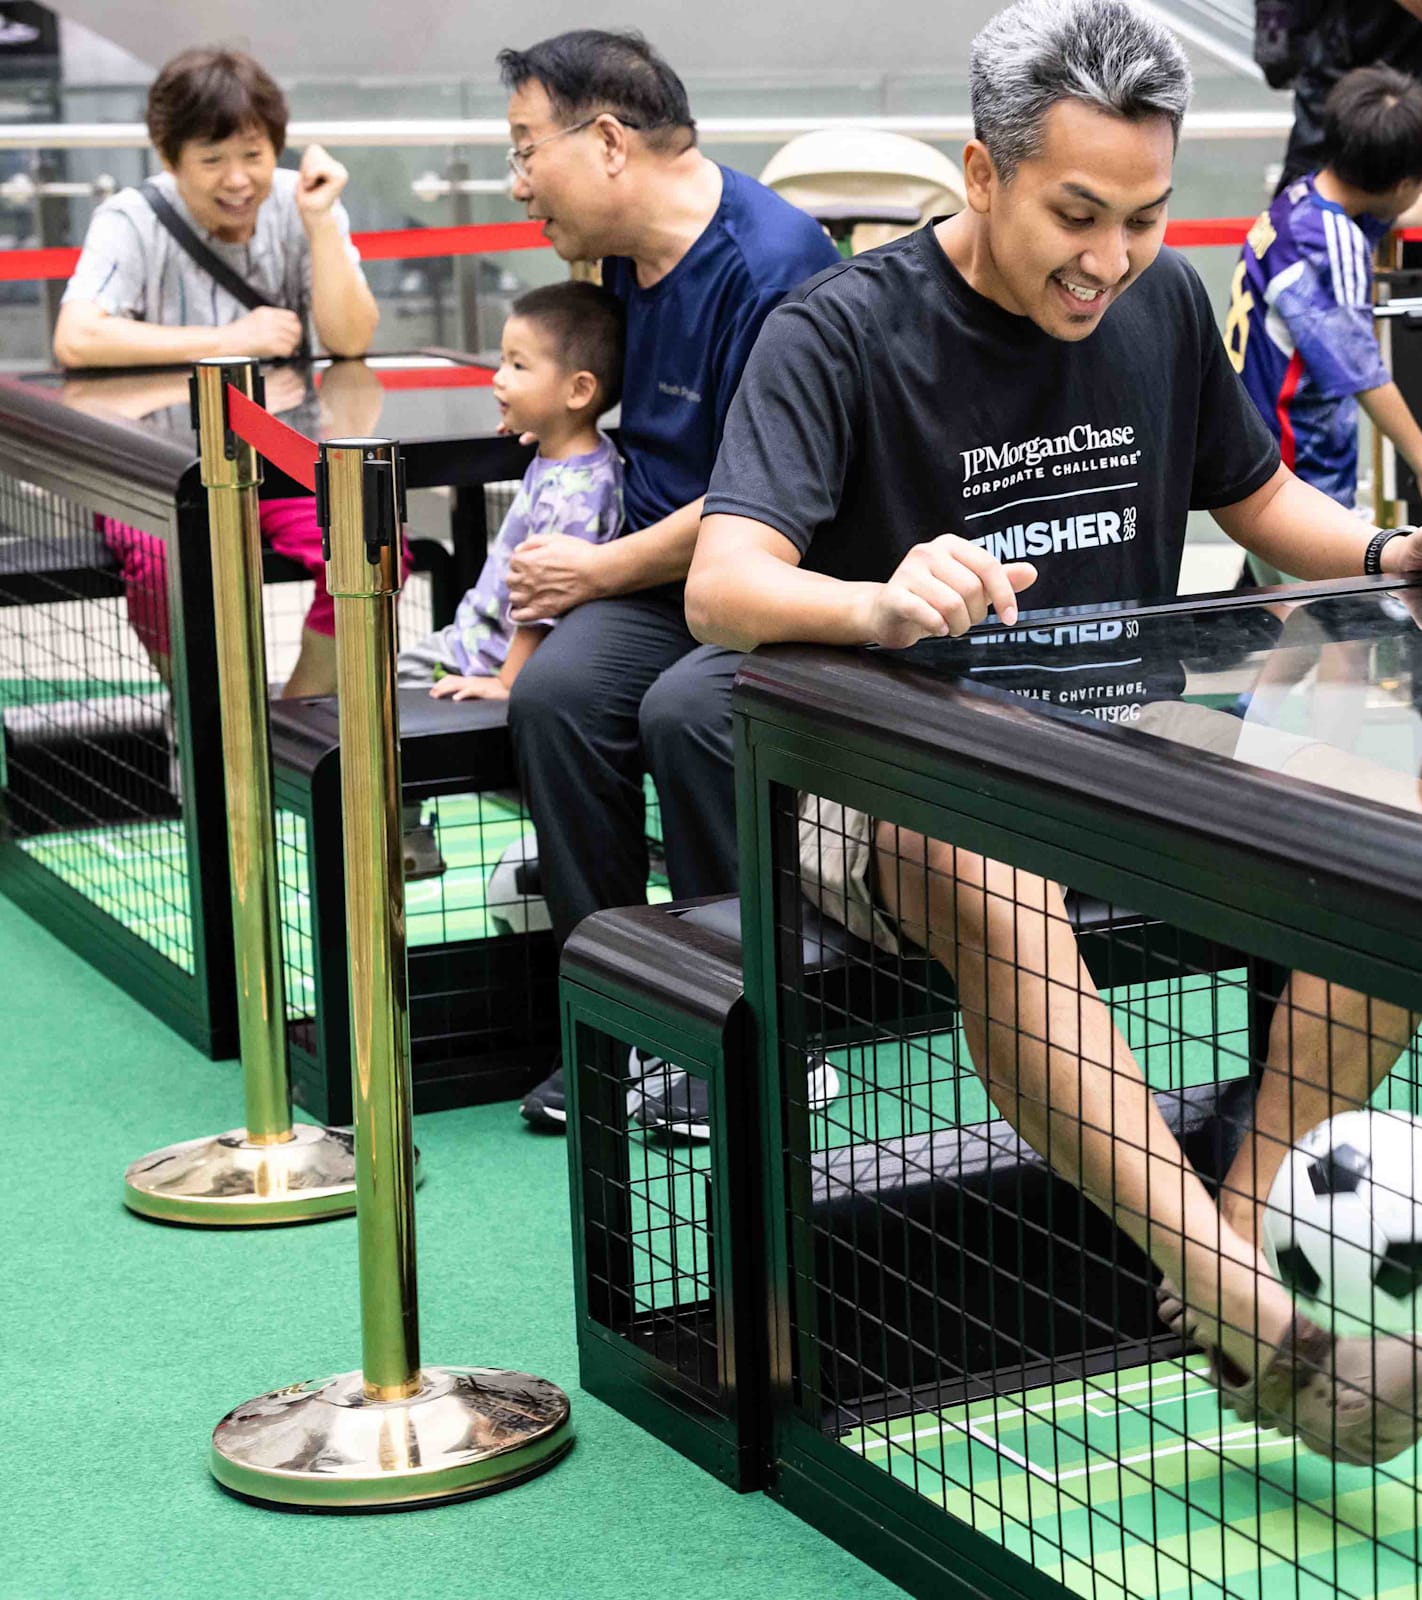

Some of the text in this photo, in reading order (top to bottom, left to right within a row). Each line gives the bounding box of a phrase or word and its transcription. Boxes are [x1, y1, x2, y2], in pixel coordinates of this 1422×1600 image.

[960, 424, 1135, 482] JPMorganChase
[963, 468, 1045, 498] CORPORATE
[1123, 506, 1137, 525] 20
[1123, 523, 1137, 541] 26
